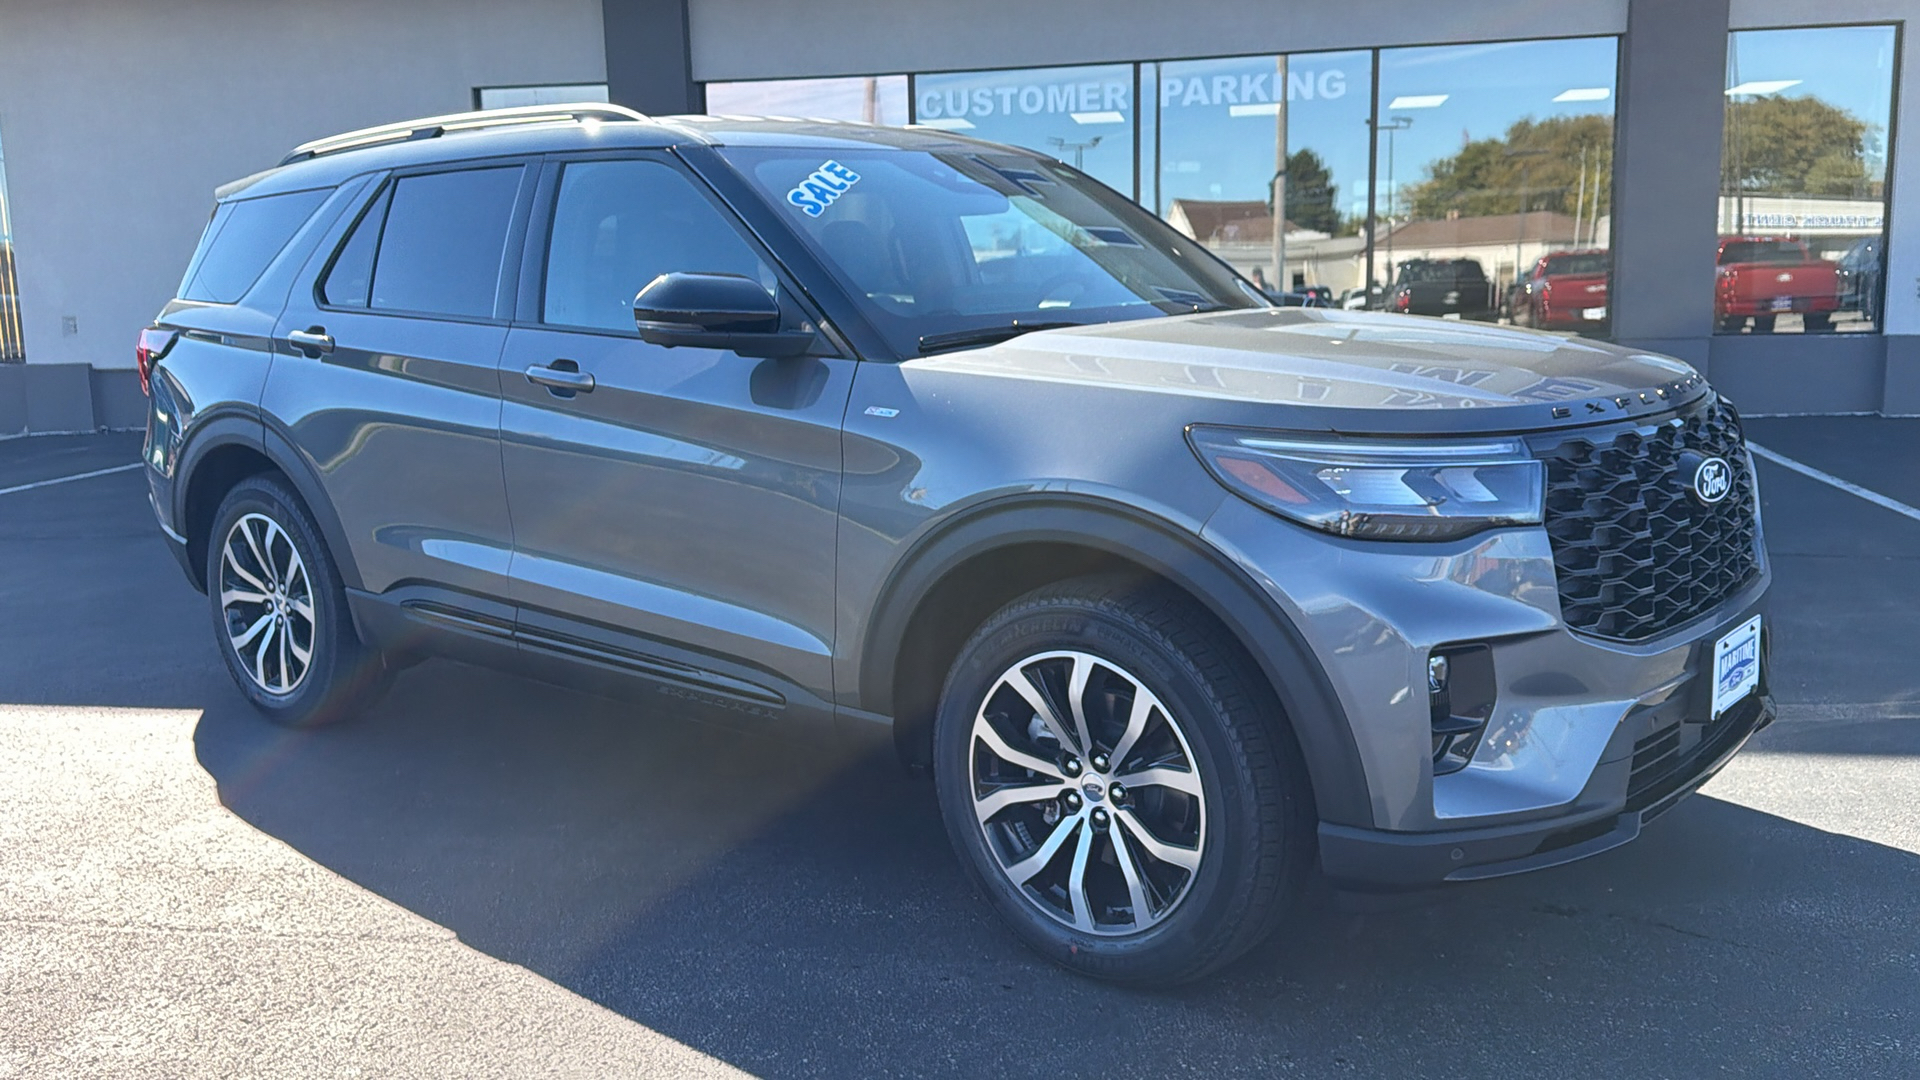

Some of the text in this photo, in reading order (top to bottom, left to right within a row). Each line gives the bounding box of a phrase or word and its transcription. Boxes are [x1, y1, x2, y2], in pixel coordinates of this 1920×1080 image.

[918, 69, 1347, 119] CUSTOMER PARKING
[788, 161, 860, 217] SALE
[1551, 374, 1703, 419] EXPLORER
[1702, 463, 1727, 497] Ford
